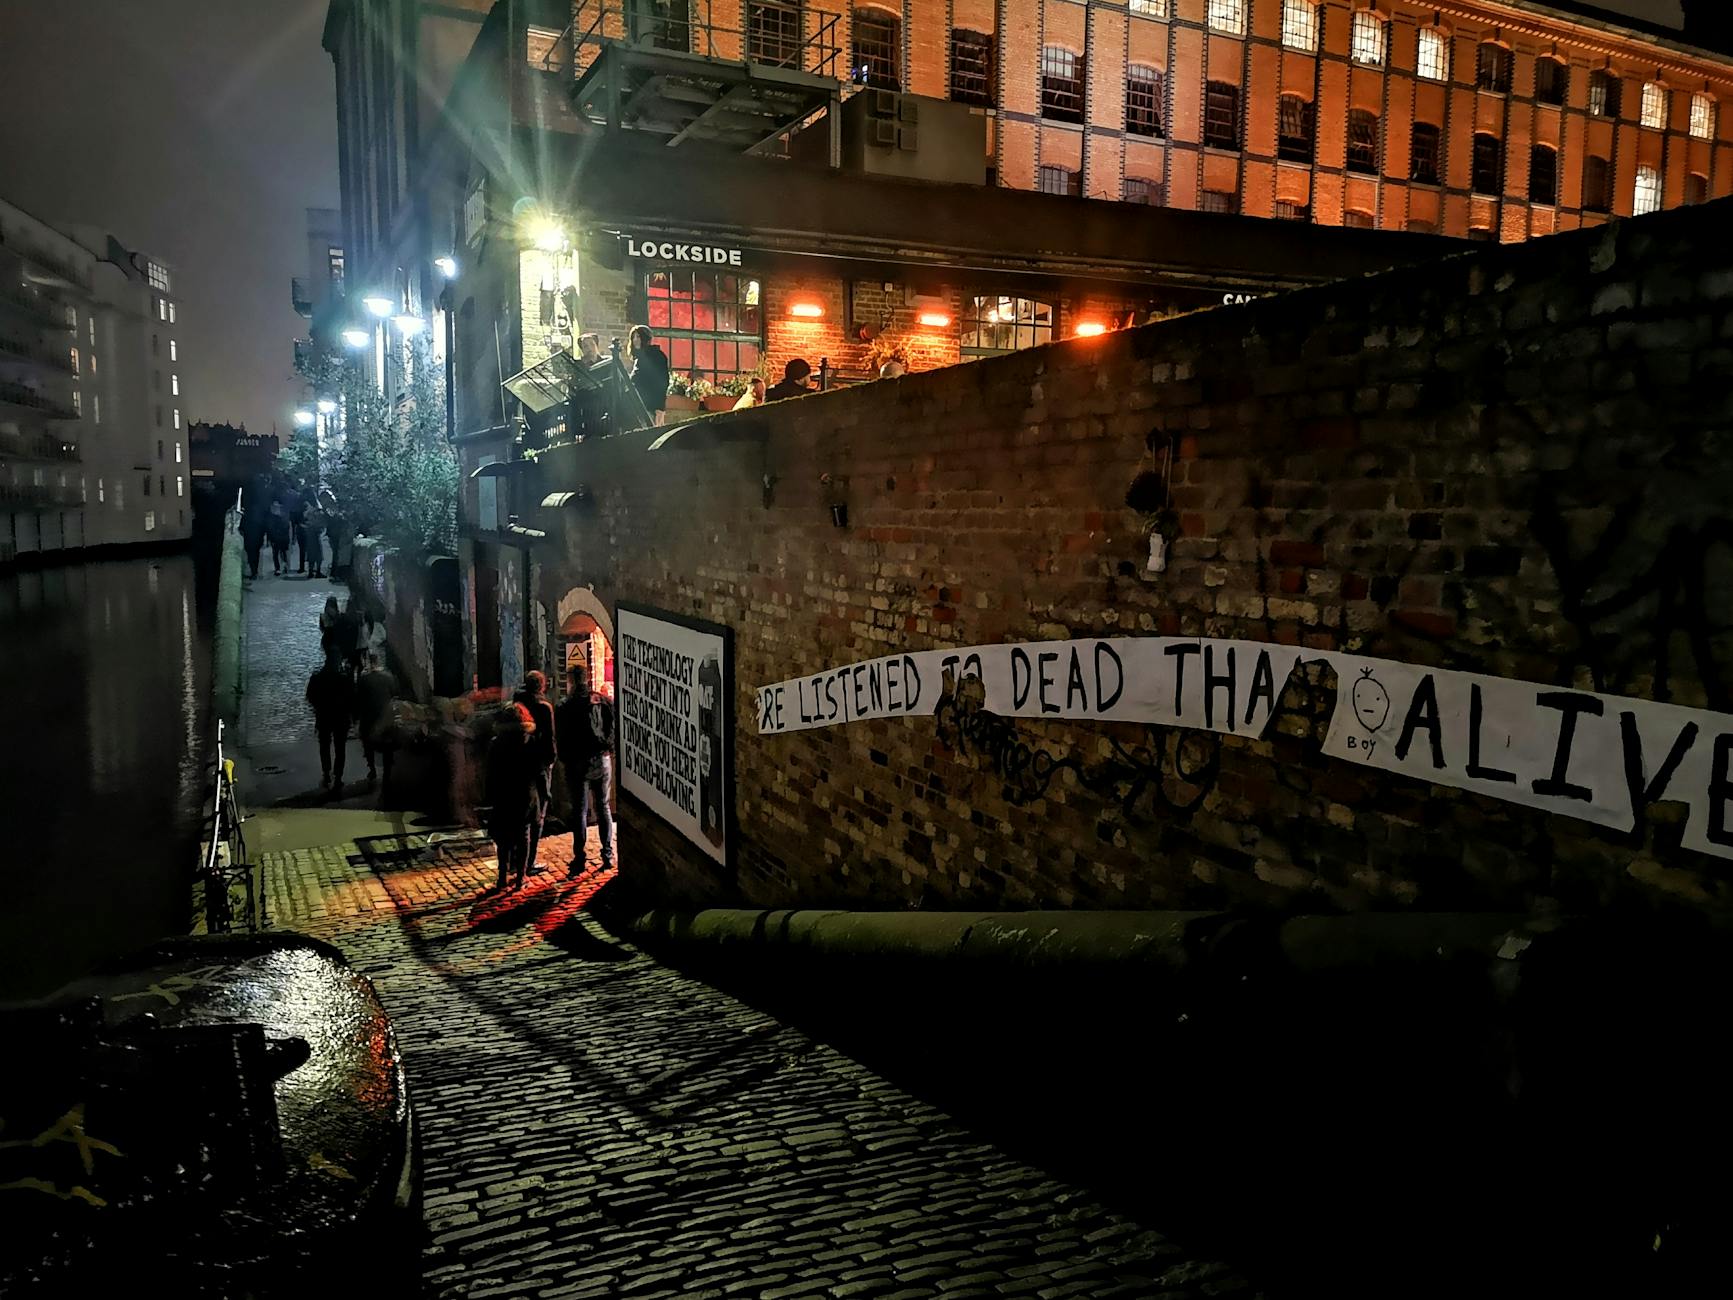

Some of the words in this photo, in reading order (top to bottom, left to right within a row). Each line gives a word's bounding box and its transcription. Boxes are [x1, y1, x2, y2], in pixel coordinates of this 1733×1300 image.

[628, 239, 742, 266] LOCKSIDE
[622, 633, 637, 663] THE
[638, 638, 694, 688] TECHNOLOGY
[624, 661, 642, 693] THAT
[643, 670, 667, 707] WENT
[668, 681, 691, 718] INTO
[622, 688, 638, 719] THIS
[640, 696, 653, 729] OAT
[655, 705, 682, 746] DRINK
[684, 720, 697, 753] AD
[798, 655, 921, 723] LISTENED
[1010, 641, 1123, 714] DEAD
[1163, 643, 1275, 732] THA
[1395, 673, 1733, 847] ALIVE
[1347, 735, 1378, 760] BOY
[622, 714, 652, 757] FINDING
[653, 733, 670, 769] YOU
[671, 745, 697, 787] HERE
[625, 743, 632, 770] IS
